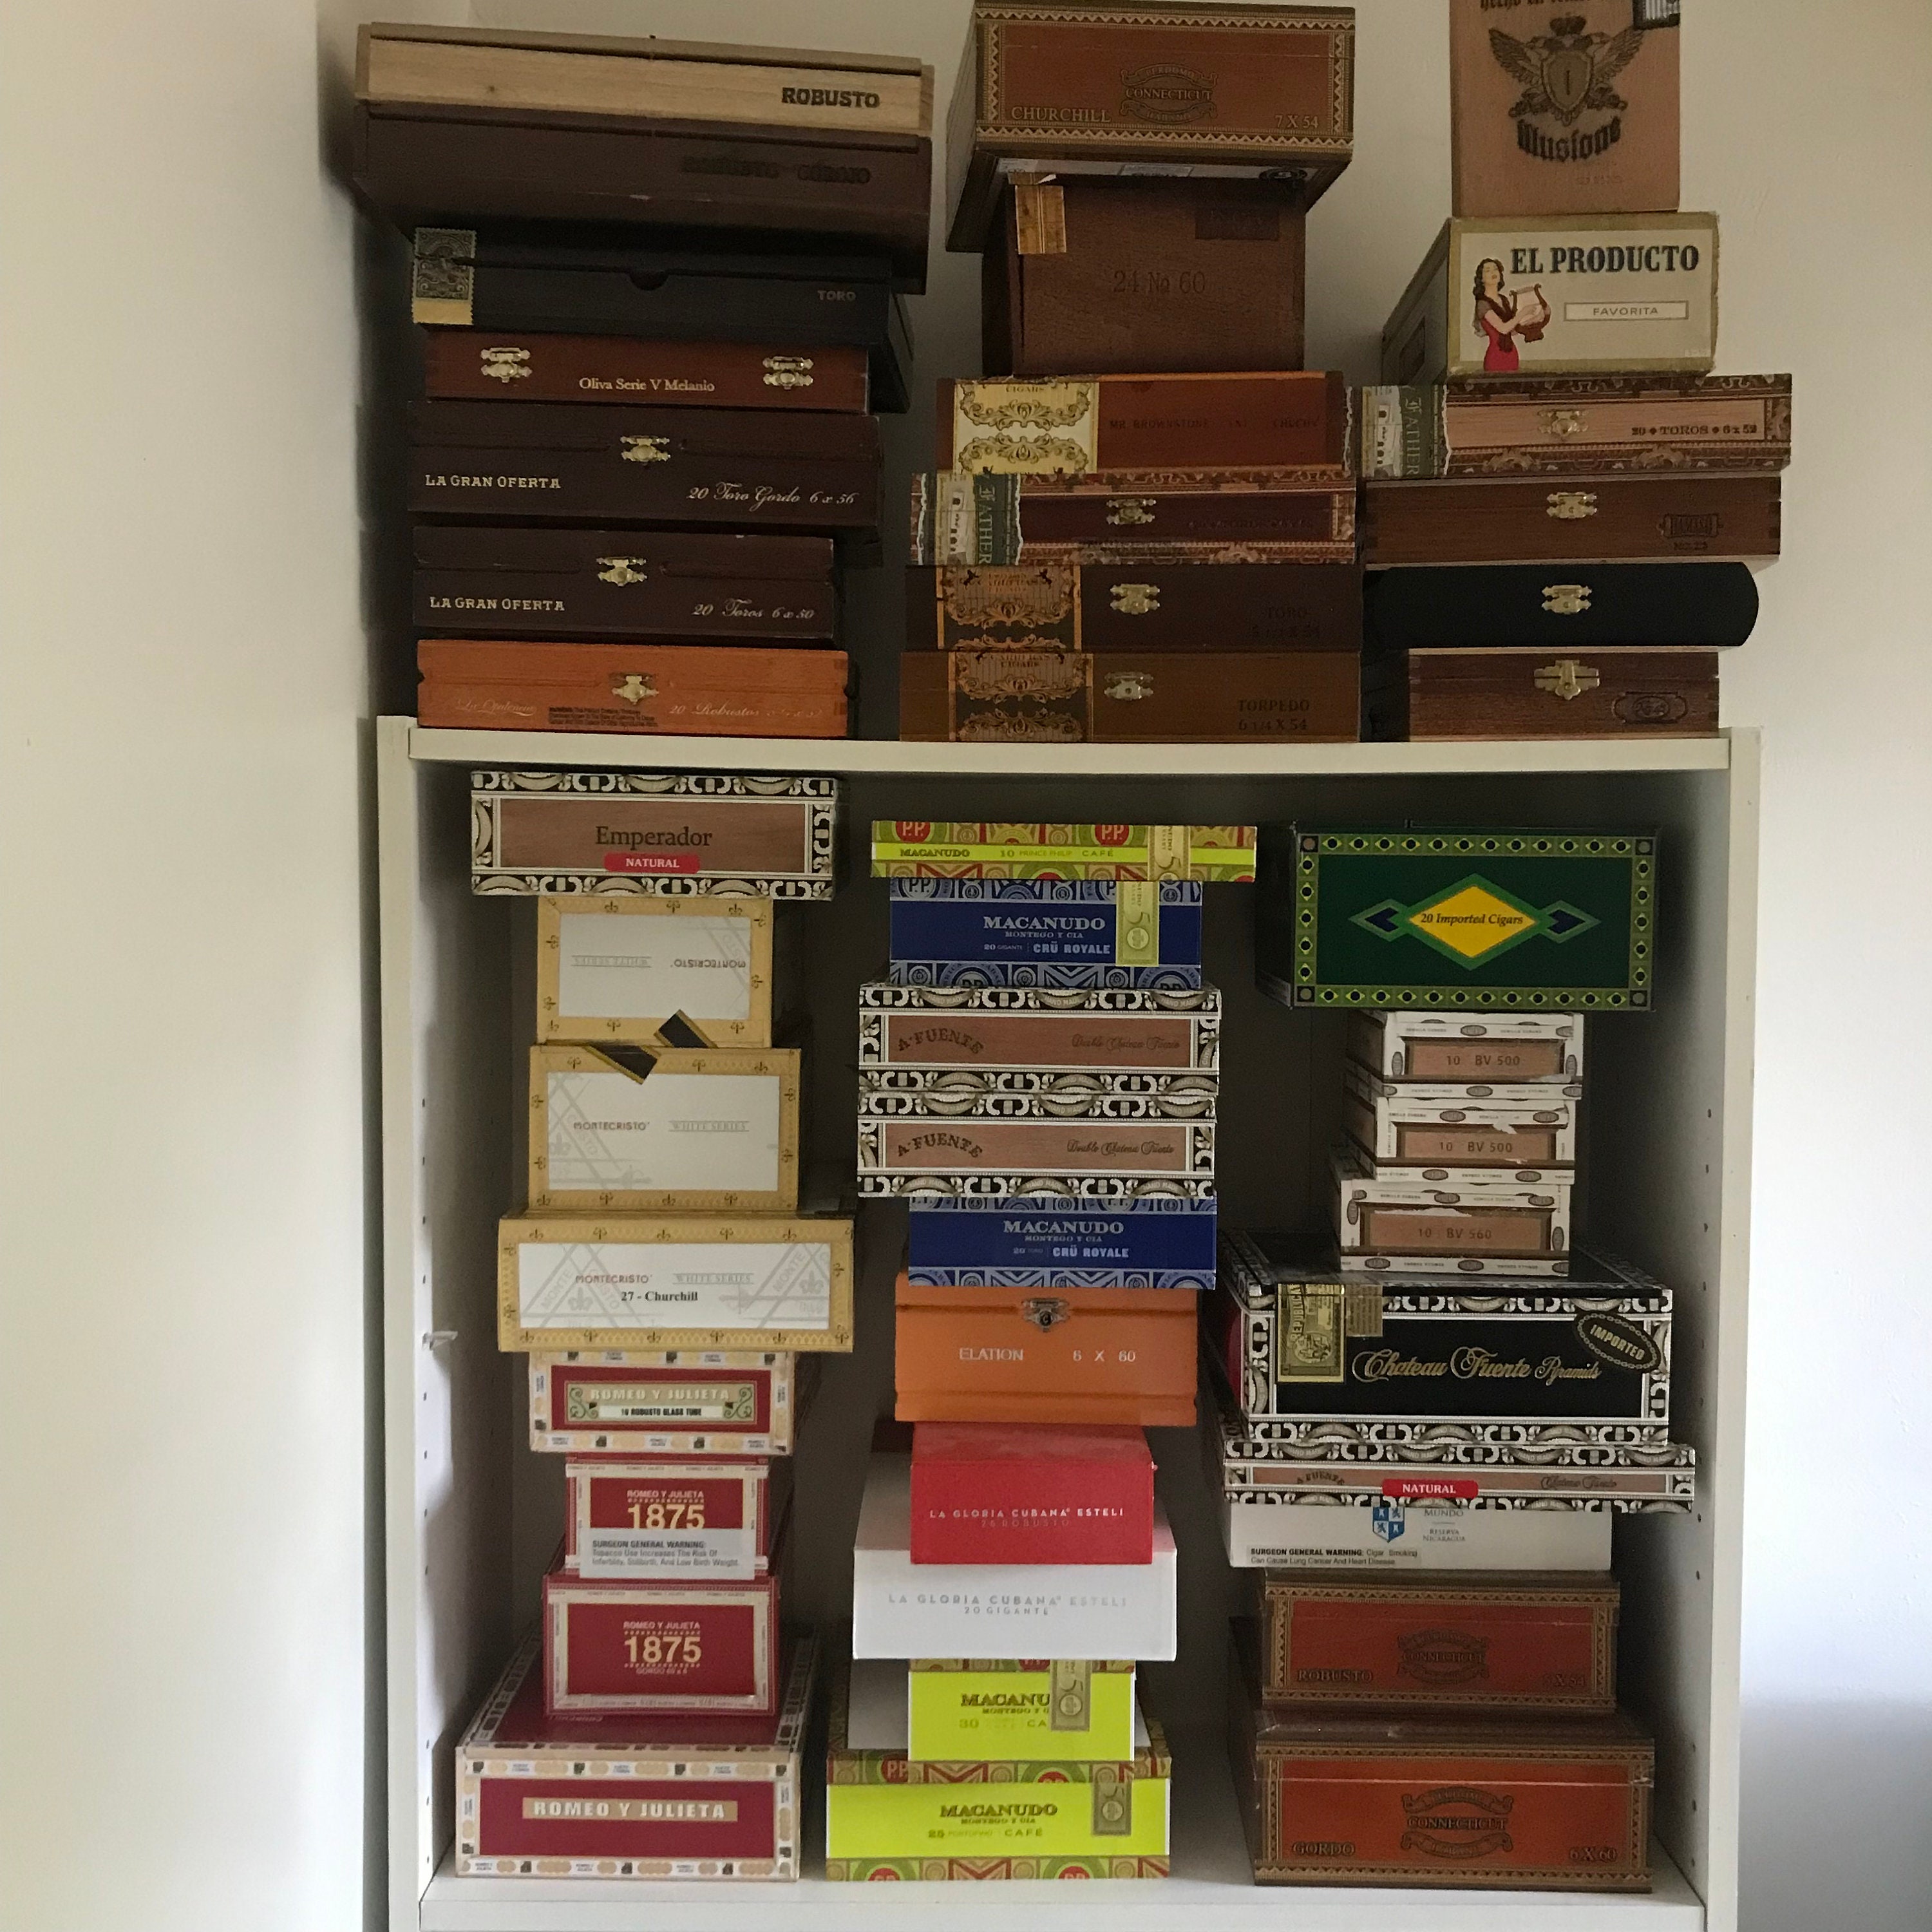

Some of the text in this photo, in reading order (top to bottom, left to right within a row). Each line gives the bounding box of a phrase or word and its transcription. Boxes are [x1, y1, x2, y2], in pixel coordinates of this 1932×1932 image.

[781, 86, 880, 108] ROBUSTO
[1126, 88, 1213, 100] CONNECTICUT
[1011, 106, 1112, 124] CHURCHILL
[1275, 114, 1319, 129] 7 X 54
[1510, 245, 1700, 275] EL PRODUCTO
[1113, 270, 1206, 294] 24 60
[817, 290, 857, 301] TORO
[1593, 305, 1659, 316] FAVORITA
[579, 377, 715, 392] Oliva Serie V Melanio
[1631, 424, 1757, 436] 20 TOROS 6 52
[426, 474, 562, 490] LA GRAN OFERTA
[687, 480, 856, 512] 20 Toro Gordo 6 56
[430, 596, 565, 612] LA GRAN OFERTA
[692, 602, 714, 617] 20
[771, 607, 781, 620] 6
[690, 698, 760, 716] Robustos
[1238, 699, 1310, 712] TORPEDO
[1290, 718, 1308, 731] 54
[594, 825, 713, 849] Emperador
[900, 849, 971, 857] MACANUDO
[1082, 848, 1113, 857] CAFÉ
[625, 857, 680, 869] NATURAL
[983, 916, 1106, 931] MACANUDO
[1421, 913, 1524, 927] 20 Imported Cigars
[1064, 944, 1111, 954] ROYALE
[674, 958, 746, 969] MONTECRISTO
[1447, 1054, 1520, 1066] 10 BV 500
[573, 1122, 647, 1131] MONTECRISTO
[1439, 1141, 1513, 1153] 10 BV 500
[1003, 1220, 1124, 1234] MACANUDO
[1419, 1227, 1492, 1239] 10 BV 560
[1083, 1247, 1130, 1258] ROYALE
[575, 1274, 650, 1283] MONTECRISTO
[715, 1274, 751, 1283] SERIES
[621, 1291, 698, 1302] 27 Churchill
[1590, 1324, 1645, 1360] IMPORTED
[959, 1347, 1136, 1362] ELATION 6 X 60
[1352, 1346, 1602, 1385] Chateau Fuente Pyramids
[590, 1388, 730, 1400] ROMEO Y JULIETA
[627, 1490, 705, 1499] ROMEO JULIETA
[1402, 1484, 1457, 1493] NATURAL
[627, 1503, 705, 1530] 1875
[930, 1508, 1124, 1519] LA GLORIA ESTELI
[1424, 1508, 1464, 1517] MUNDO
[592, 1540, 629, 1548] SURGEON
[1251, 1548, 1287, 1556] SURGEON
[1366, 1549, 1384, 1558] Cigar
[1289, 1557, 1307, 1566] Lung
[888, 1594, 907, 1604] LA
[917, 1594, 980, 1604] GLORIA
[1069, 1596, 1126, 1607] ESTELI
[964, 1606, 1048, 1616] 20 GIGANTE
[623, 1621, 701, 1630] ROMEO JULIETA
[623, 1636, 702, 1663] 1875
[1403, 1651, 1484, 1662] CONNECTICUT
[1296, 1669, 1373, 1682] ROBUSTO
[960, 1694, 1051, 1706] MACANU
[533, 1801, 725, 1819] ROMEO Y JULIETA
[940, 1804, 1058, 1817] MACANUDO
[1407, 1816, 1509, 1830] CONNECTICUT
[1005, 1828, 1043, 1837] CAFÉ
[1292, 1842, 1356, 1856] GORDO
[1569, 1848, 1616, 1861] 6 X 60
